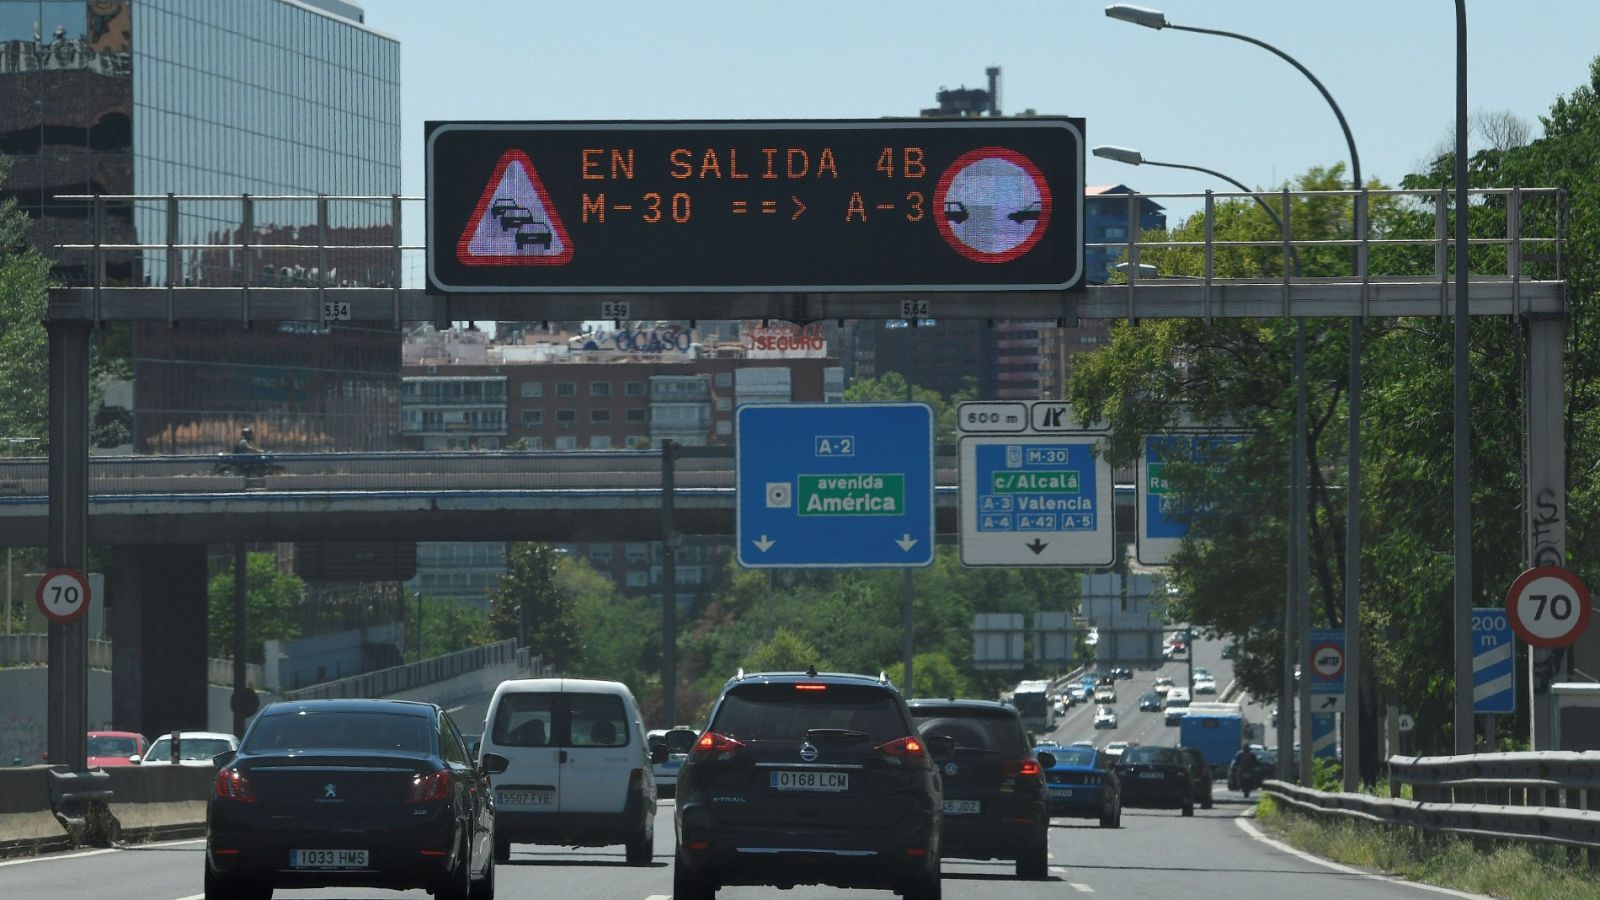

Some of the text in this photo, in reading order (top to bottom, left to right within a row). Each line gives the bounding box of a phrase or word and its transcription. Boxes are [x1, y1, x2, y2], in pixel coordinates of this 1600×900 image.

[581, 147, 927, 180] EN SALIDA 4B
[581, 191, 692, 224] M-30
[845, 191, 926, 223] A-3
[615, 329, 691, 351] OCASO
[967, 412, 1018, 424] 600 m
[819, 439, 851, 453] A-2
[1029, 450, 1066, 462] M-30
[818, 476, 883, 490] avenida
[994, 472, 1078, 489] c/Alcalá
[806, 492, 896, 512] América
[983, 495, 1092, 510] A-3 Valencia
[983, 515, 1091, 528] A-4 A-42 A-5
[51, 586, 79, 604] 70
[1529, 594, 1572, 622] 70
[1472, 616, 1506, 632] 200
[1481, 634, 1497, 646] m
[780, 772, 846, 788] 0168 LCM
[301, 851, 365, 865] 1033 HMS
